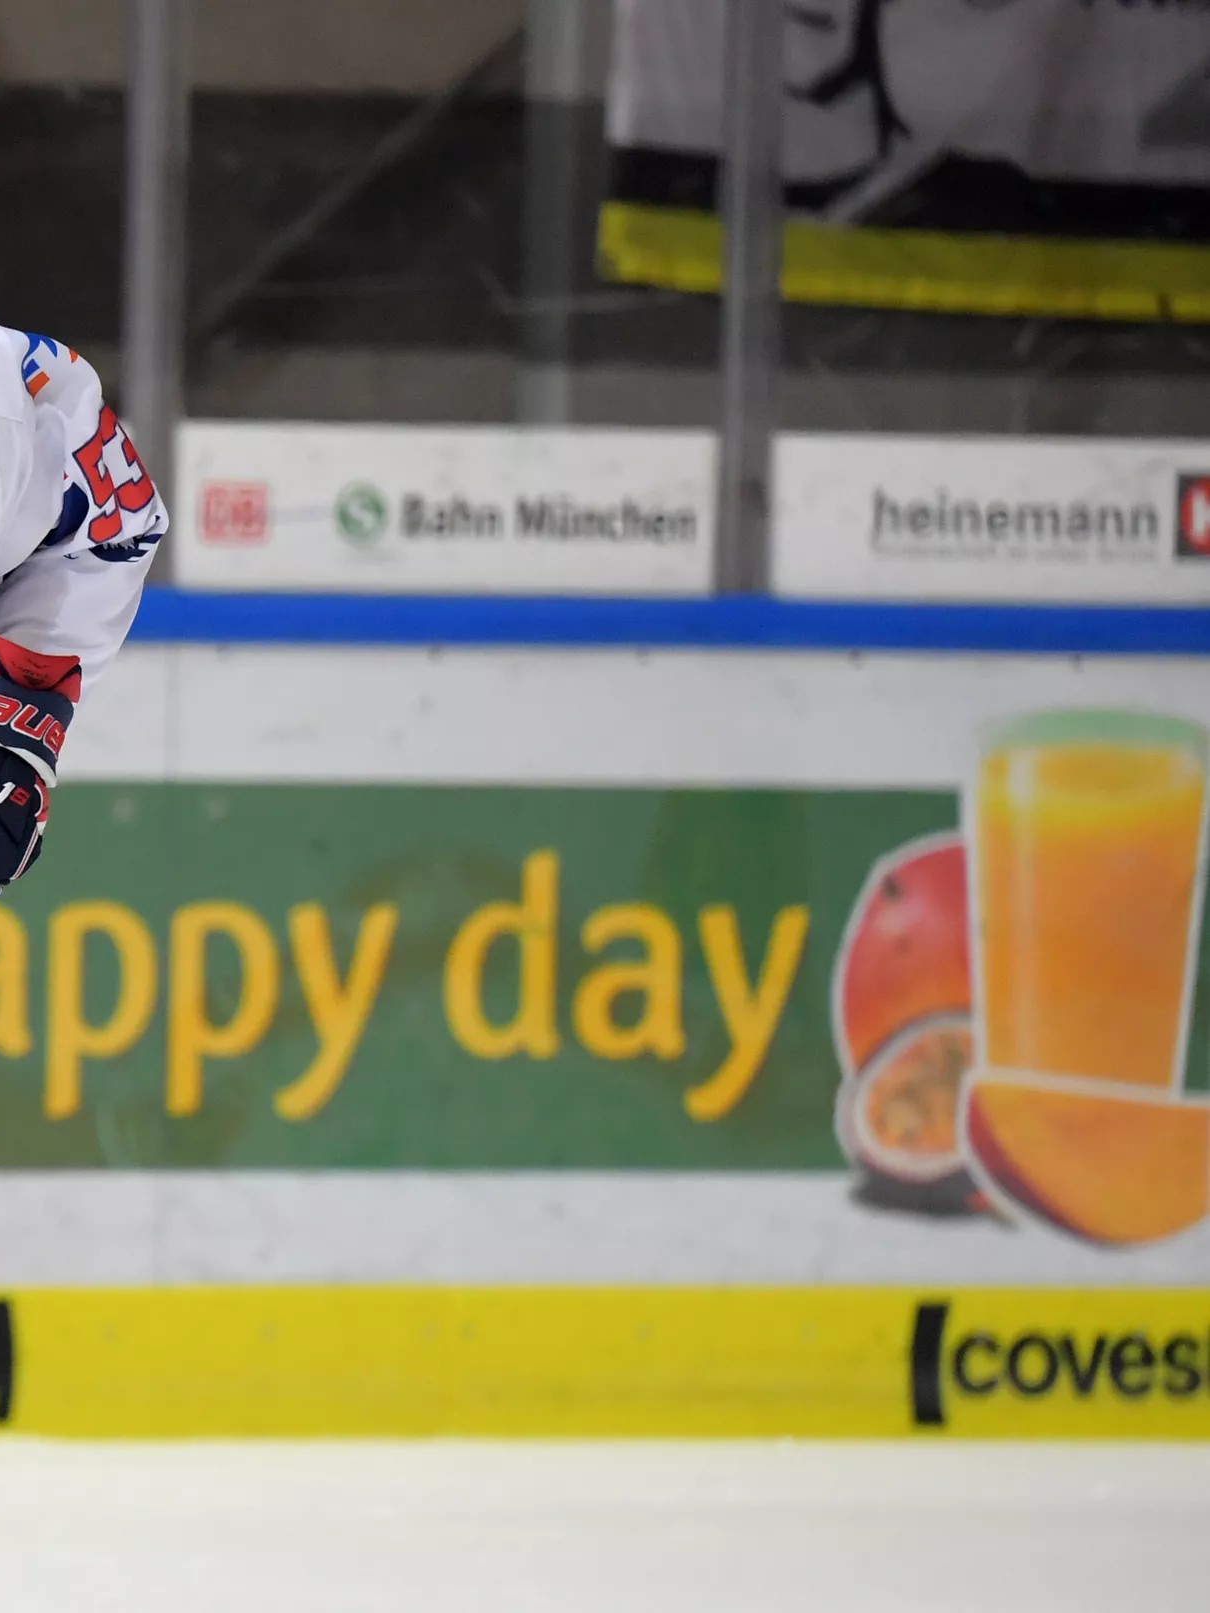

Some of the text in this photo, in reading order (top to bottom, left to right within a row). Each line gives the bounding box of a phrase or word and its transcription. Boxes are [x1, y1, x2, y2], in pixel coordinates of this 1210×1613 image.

[400, 493, 503, 541] Bahn
[515, 493, 697, 544] München
[872, 486, 1160, 541] heinemann
[444, 848, 809, 1123] day
[952, 1330, 1210, 1397] coves
